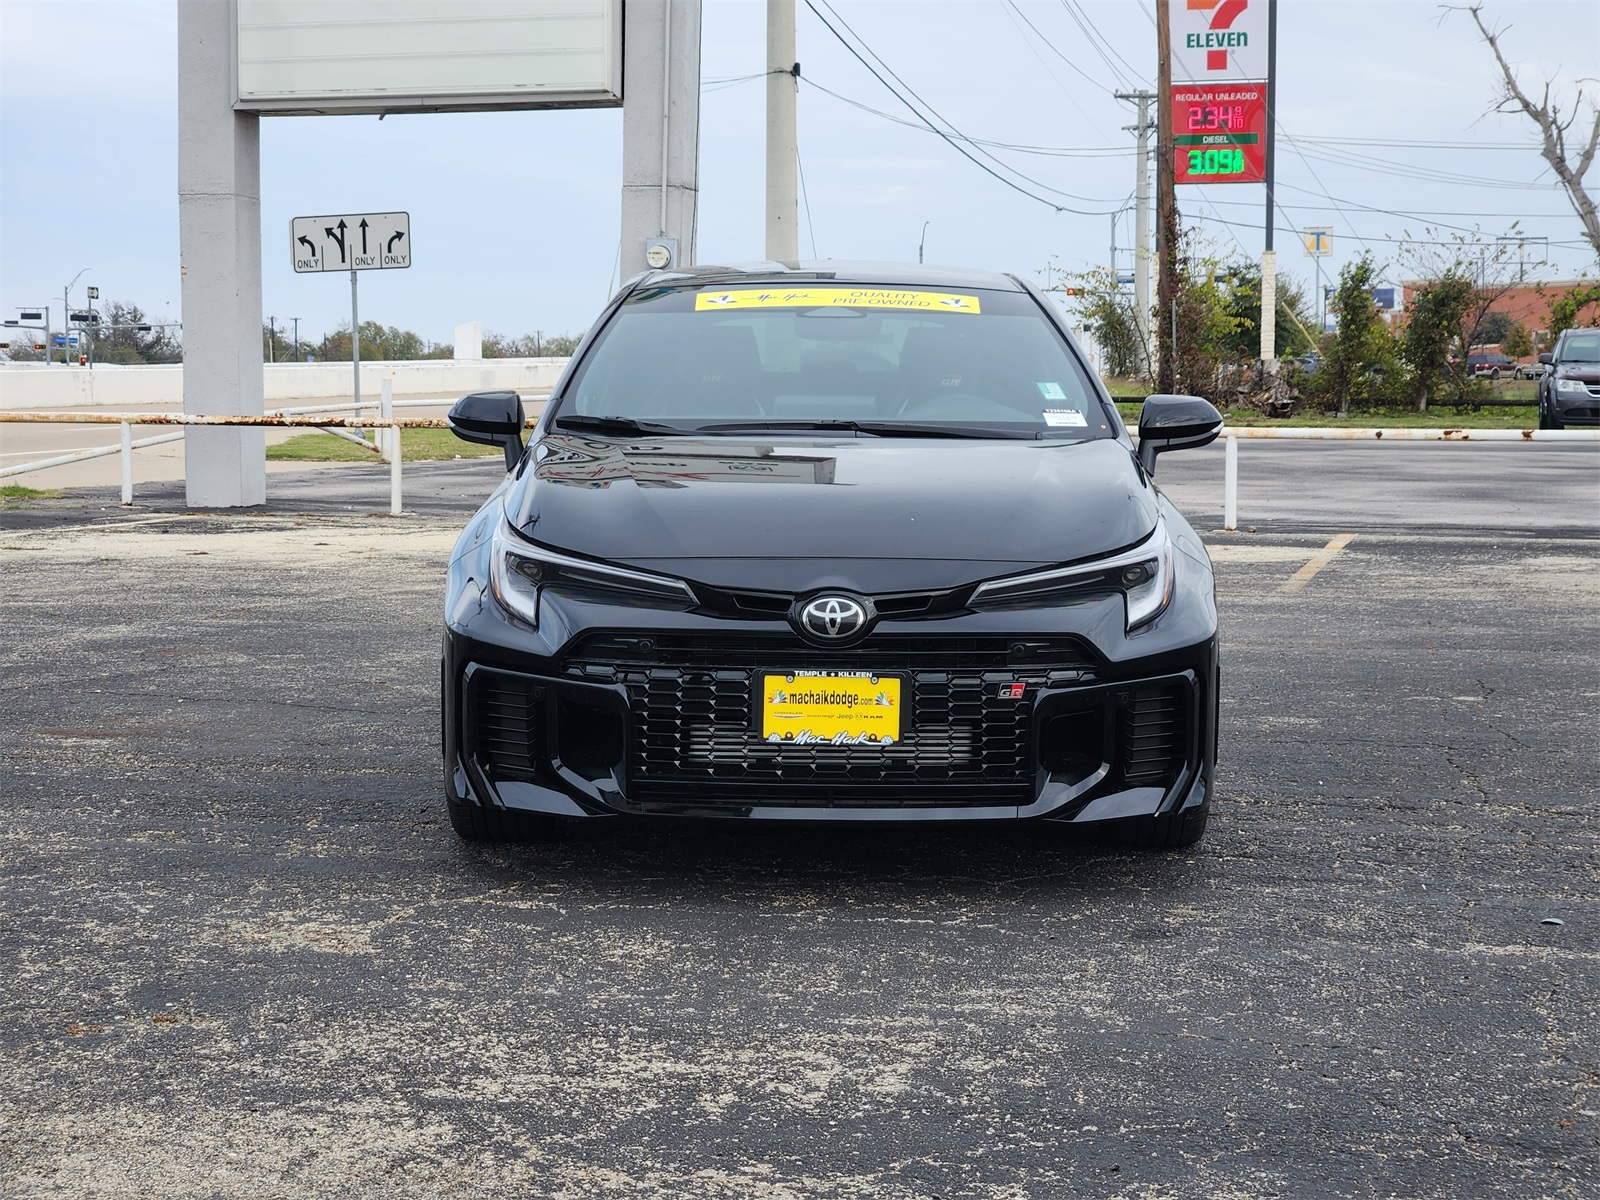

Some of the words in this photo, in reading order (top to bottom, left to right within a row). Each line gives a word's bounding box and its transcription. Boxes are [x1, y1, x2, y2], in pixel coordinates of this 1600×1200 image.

[1175, 93, 1213, 102] REGULAR
[1215, 92, 1258, 101] UNLEADED
[1188, 106, 1232, 130] 2.34
[1202, 136, 1229, 144] DIESEL
[1188, 149, 1233, 175] 3.09
[297, 259, 320, 269] ONLY
[355, 256, 376, 266] ONLY
[384, 255, 407, 264] ONLY
[850, 291, 920, 299] QUALITY
[832, 297, 931, 307] PRE-OWNED
[789, 690, 874, 709] machaikdodge.com
[793, 729, 830, 745] Mac
